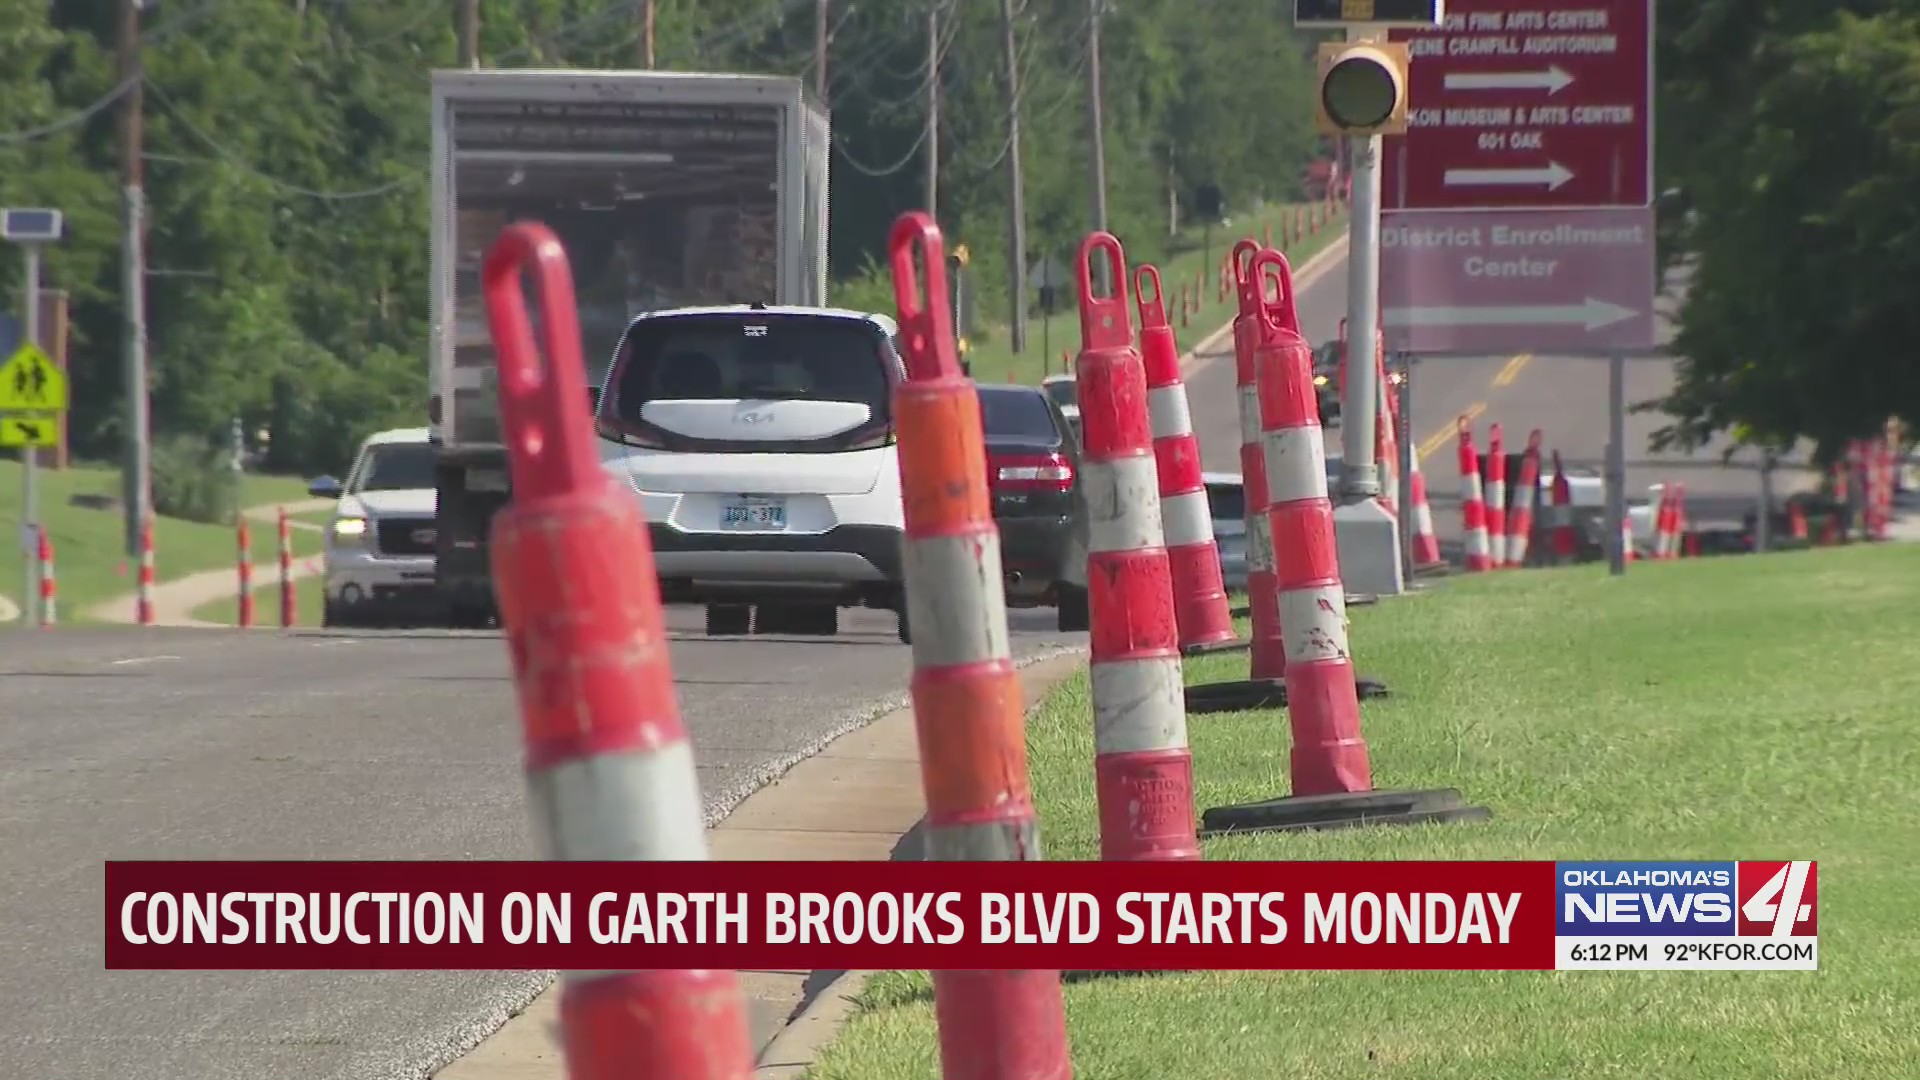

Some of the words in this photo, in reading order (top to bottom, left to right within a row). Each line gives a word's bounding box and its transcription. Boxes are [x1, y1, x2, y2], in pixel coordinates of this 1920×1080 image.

[1469, 11, 1504, 31] FINE
[1505, 10, 1545, 30] ARTS
[1547, 9, 1608, 29] CENTER
[1407, 37, 1446, 57] GENE
[1448, 36, 1520, 56] CRANFILL
[1522, 35, 1617, 54] AUDITORIUM
[1406, 108, 1442, 127] KON
[1444, 107, 1512, 126] MUSEUM
[1514, 106, 1526, 126] &
[1528, 106, 1569, 126] ARTS
[1571, 105, 1633, 124] CENTER
[1477, 132, 1506, 150] 601
[1510, 131, 1543, 149] OAK
[1381, 226, 1481, 248] District
[1491, 224, 1644, 246] Enrollment
[1464, 255, 1559, 277] Center
